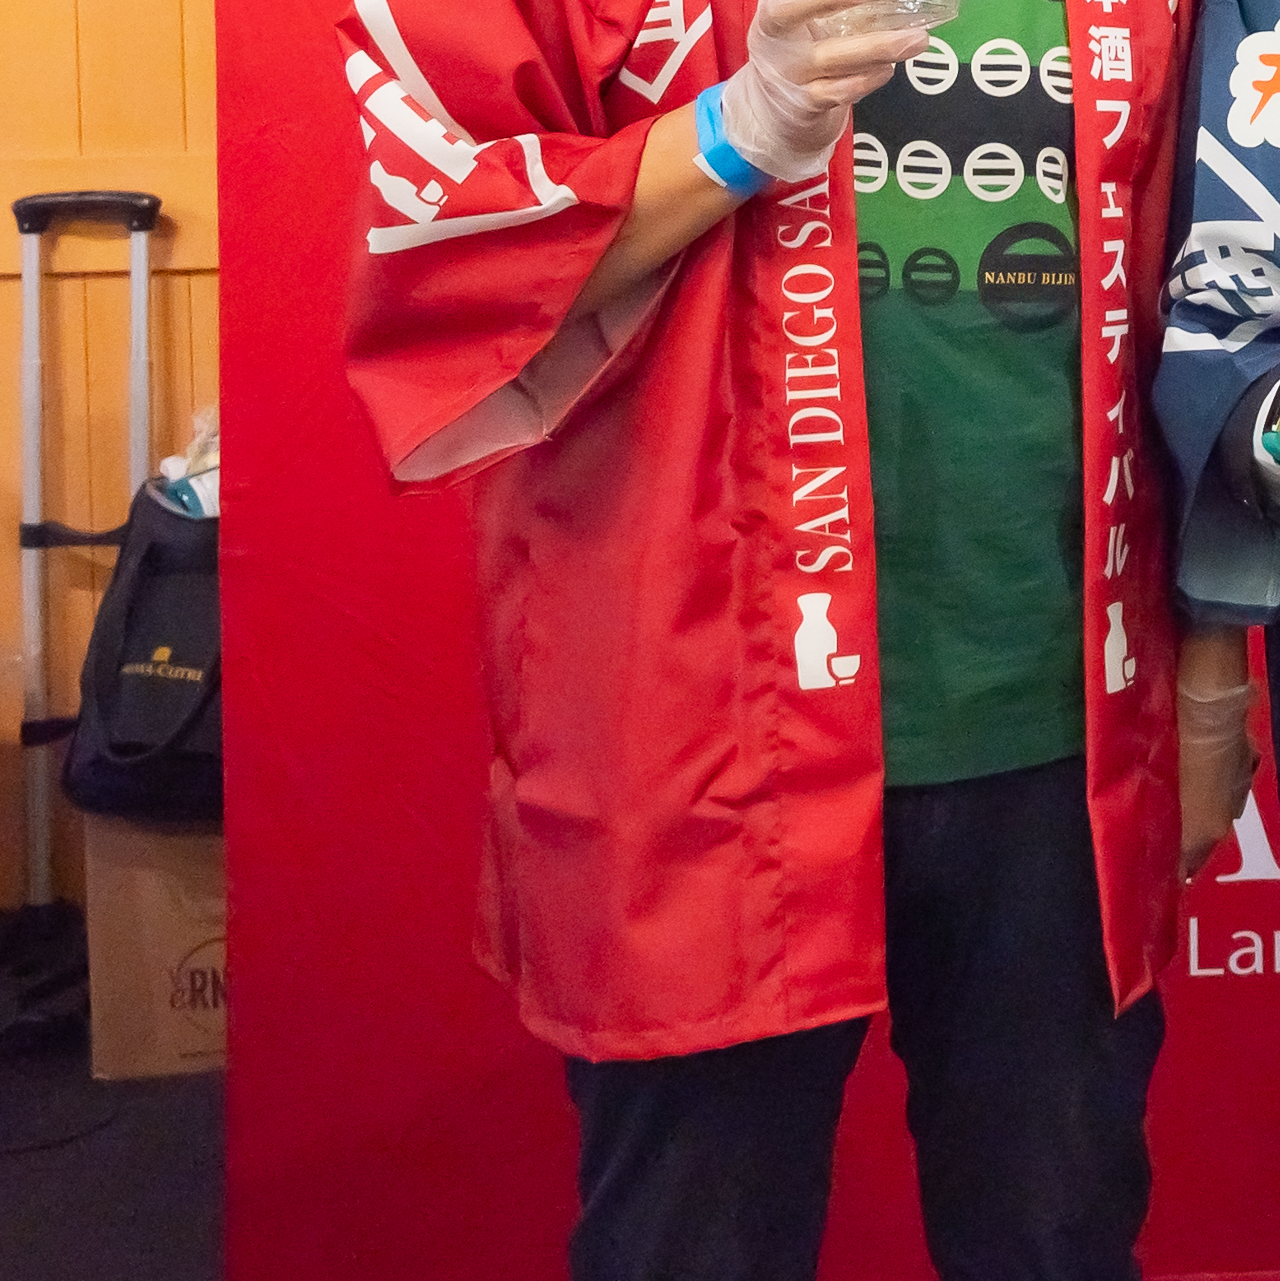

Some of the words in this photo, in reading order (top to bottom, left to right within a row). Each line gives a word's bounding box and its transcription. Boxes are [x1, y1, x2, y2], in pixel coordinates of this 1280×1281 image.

[984, 270, 1037, 286] NANBU
[1041, 271, 1076, 286] BIJIN
[781, 264, 844, 449] DIEGO
[793, 464, 853, 573] SAN
